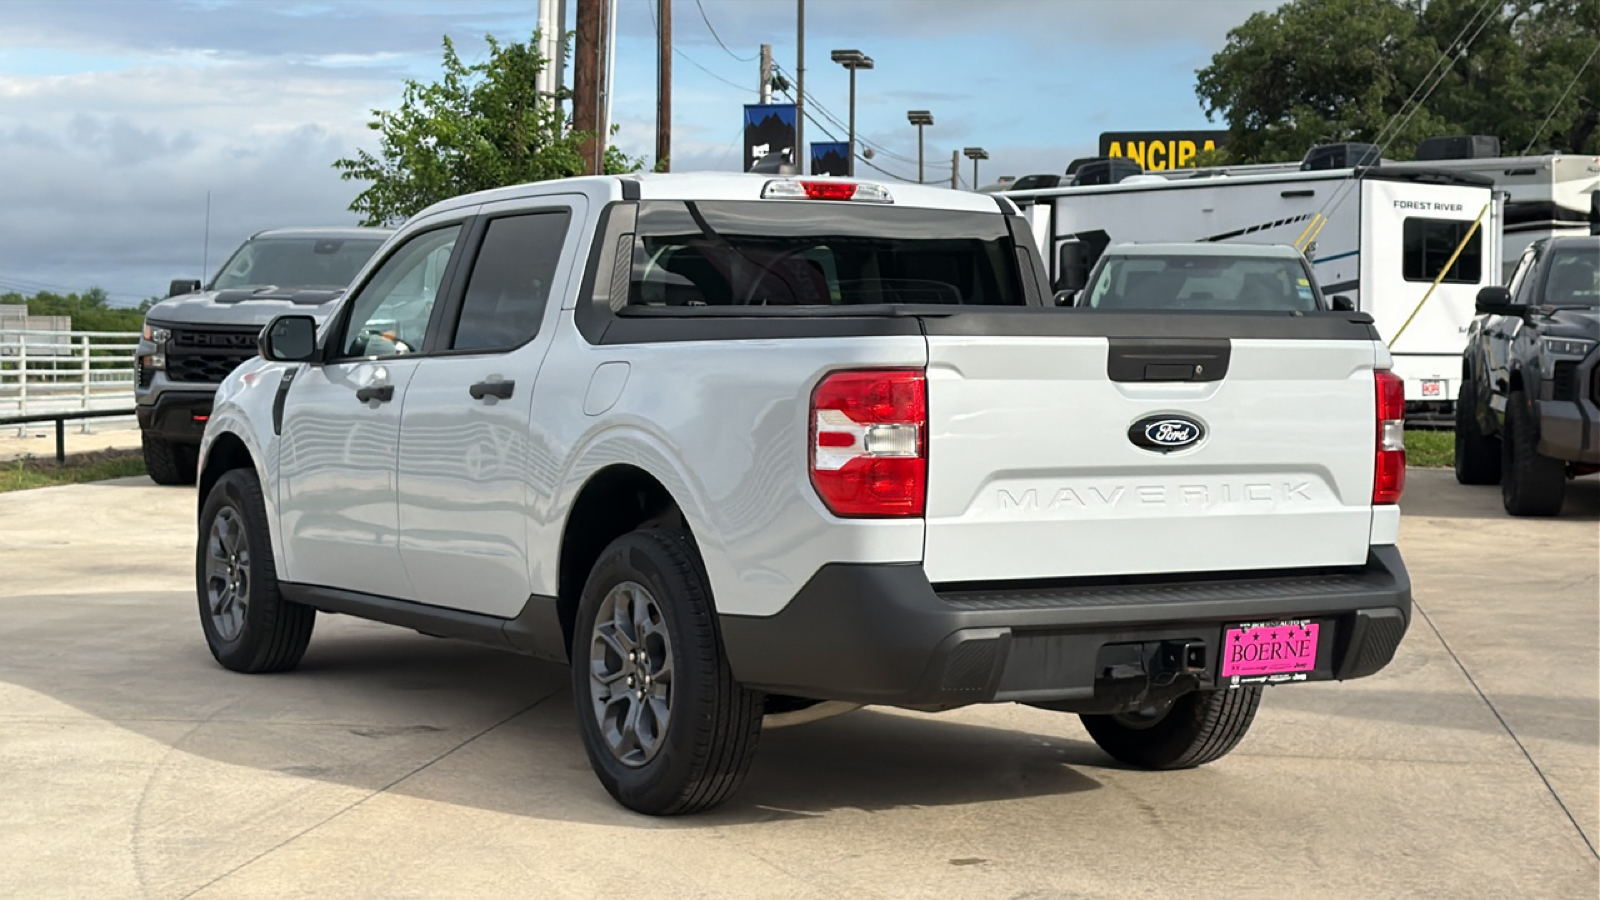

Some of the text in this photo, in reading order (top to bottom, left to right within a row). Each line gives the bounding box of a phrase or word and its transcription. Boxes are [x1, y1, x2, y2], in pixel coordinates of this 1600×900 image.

[1393, 200, 1463, 211] FOREST RIVER
[1156, 423, 1190, 441] Ford
[997, 481, 1312, 512] MAVERICK
[1231, 639, 1311, 663] BOERNE
